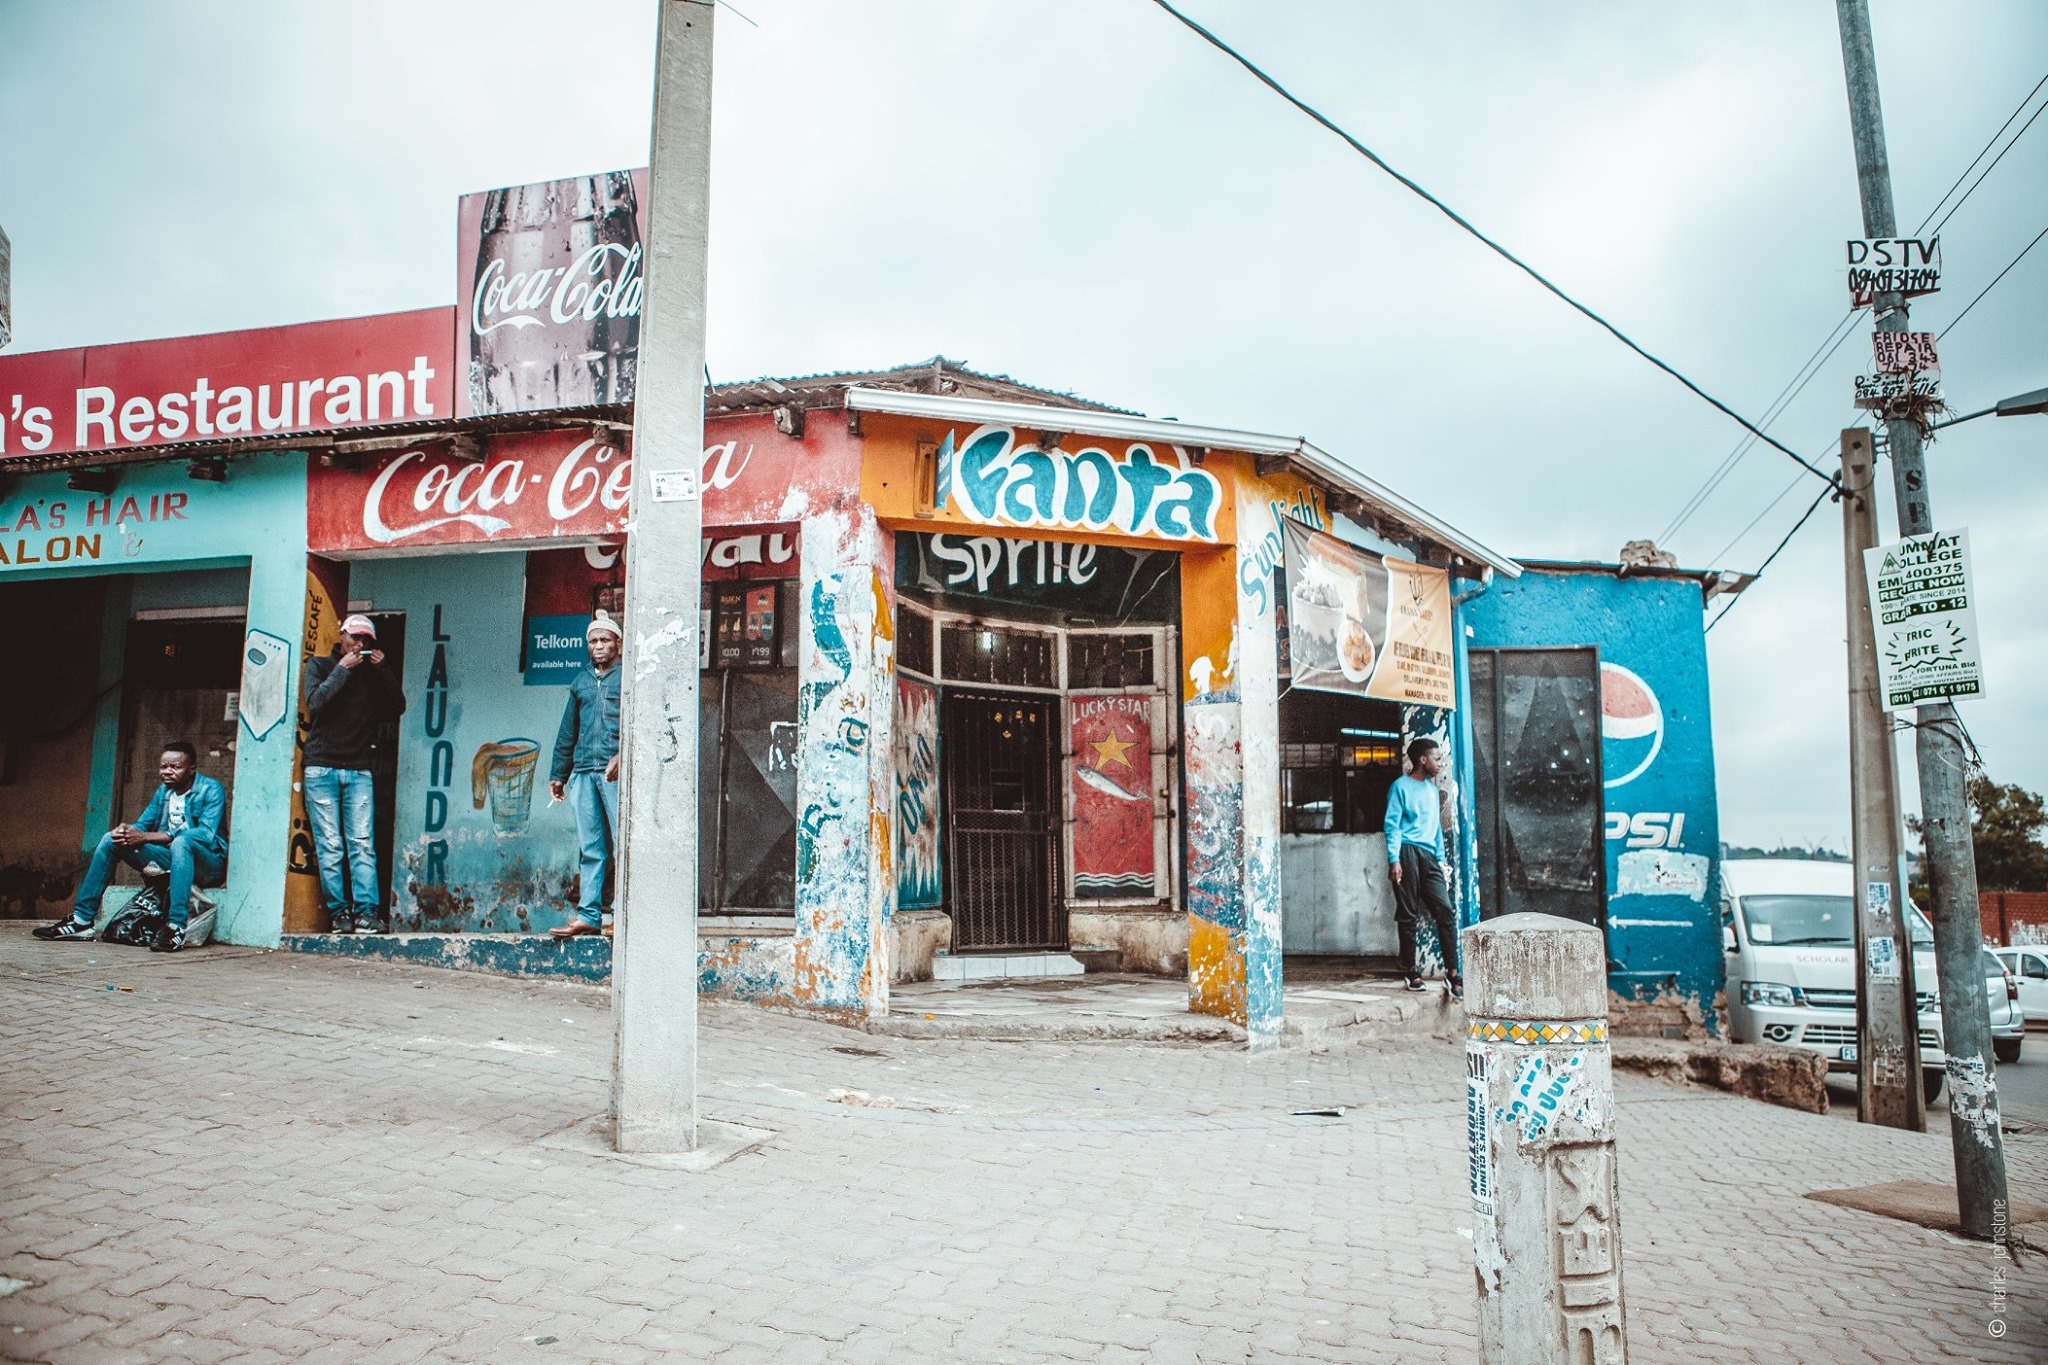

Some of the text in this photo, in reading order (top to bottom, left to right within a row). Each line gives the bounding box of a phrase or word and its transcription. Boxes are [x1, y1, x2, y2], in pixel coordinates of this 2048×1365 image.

[1847, 237, 1938, 268] DSTV
[473, 241, 643, 336] Coca-Cola
[1876, 342, 1933, 353] REPAIR
[1908, 353, 1938, 363] 343
[75, 356, 436, 450] Restaurant
[363, 438, 754, 543] Coca-Coa
[958, 428, 1214, 540] Fanta
[86, 492, 189, 527] HAIR
[1900, 535, 1960, 556] UMMAT
[1900, 548, 1963, 569] OLLEGE
[1906, 562, 1963, 579] 400375
[1929, 574, 1964, 588] NOW
[720, 595, 741, 605] BURN
[1919, 591, 1945, 600] SINCE
[1947, 587, 1966, 596] 2014
[1920, 601, 1938, 613] TO
[1949, 597, 1966, 609] 12
[534, 634, 583, 650] Telkom
[532, 659, 582, 669] available here
[1956, 682, 1977, 692] 9175
[1072, 697, 1151, 725] LUCKY STAR
[1604, 811, 1686, 849] PSI.
[1796, 954, 1850, 964] SCHOLAR
[1467, 1083, 1478, 1196] ABORTION
[1479, 1153, 1488, 1198] CLINIC
